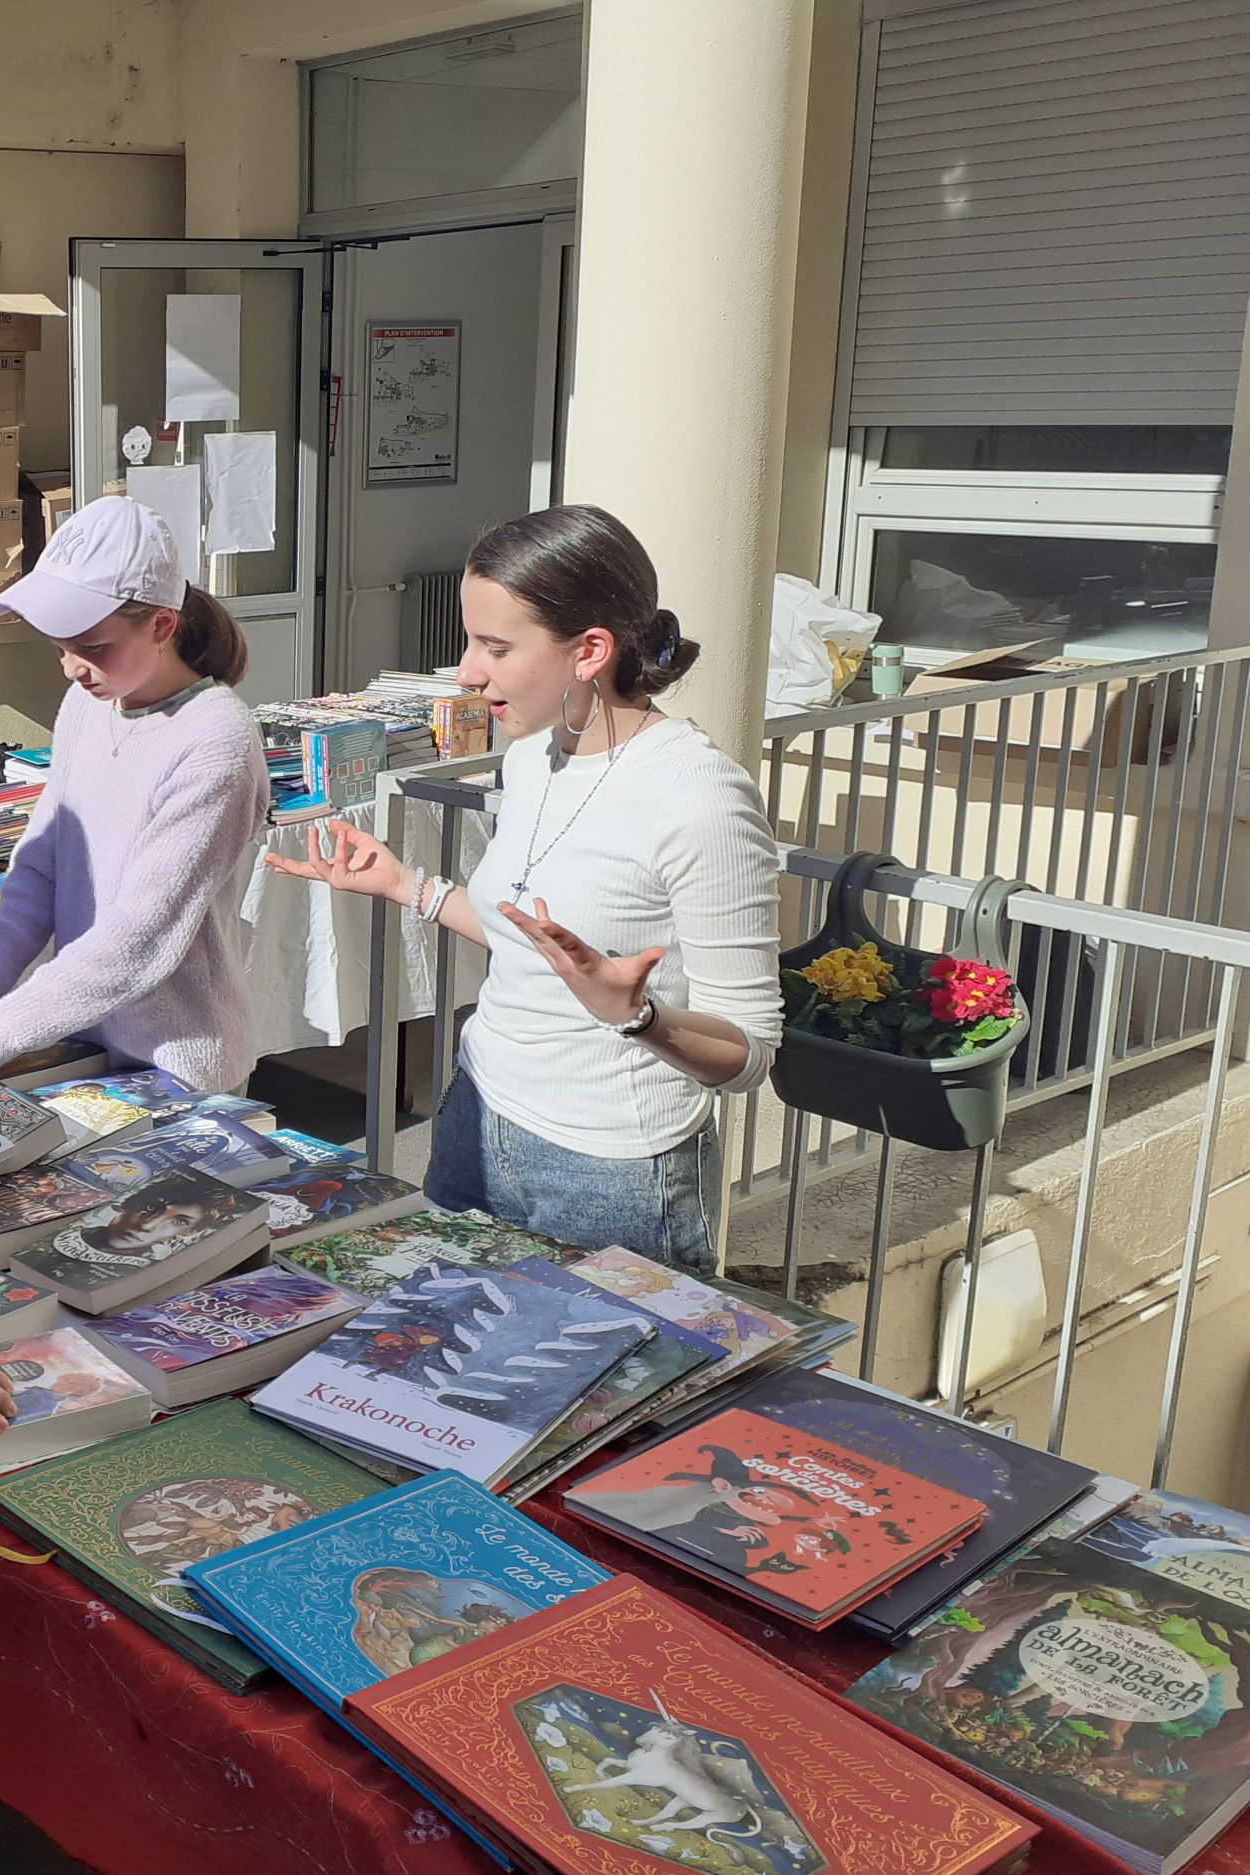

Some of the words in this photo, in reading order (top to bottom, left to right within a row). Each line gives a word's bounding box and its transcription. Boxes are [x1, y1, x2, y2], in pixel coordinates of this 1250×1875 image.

[303, 1382, 477, 1451] Krakonoche
[742, 1458, 883, 1517] sorcières
[788, 1455, 865, 1490] Contes
[800, 1470, 819, 1481] de
[475, 1523, 506, 1546] Le
[504, 1544, 574, 1587] monde
[503, 1565, 546, 1590] des
[1162, 1565, 1191, 1582] DE
[1170, 1554, 1250, 1595] ALMA
[256, 1592, 283, 1617] Emily
[286, 1619, 327, 1655] Hawkins
[1083, 1628, 1184, 1676] L'EXTRAORDINAIRE
[1026, 1638, 1060, 1658] DE
[1104, 1674, 1188, 1713] FORÊT
[1037, 1623, 1204, 1705] almanach
[1047, 1674, 1066, 1686] LES
[1068, 1683, 1125, 1713] SORCIÈRES
[421, 1718, 449, 1745] Emily
[456, 1748, 504, 1787] Hawkins
[628, 1654, 654, 1669] des
[779, 1746, 894, 1823] magiques
[657, 1641, 692, 1665] Le
[691, 1663, 771, 1712] monde
[770, 1712, 910, 1804] merveilleux
